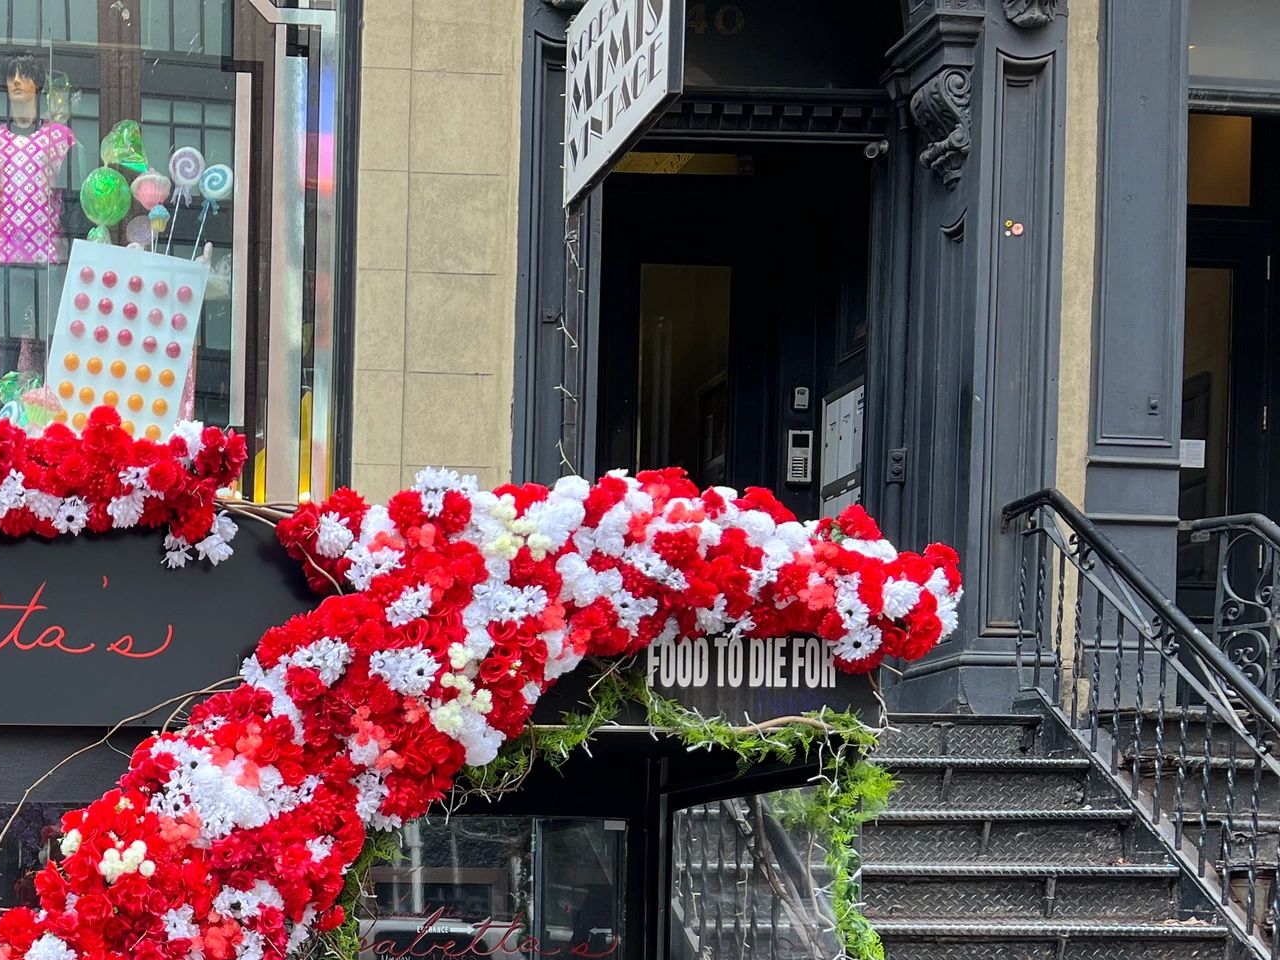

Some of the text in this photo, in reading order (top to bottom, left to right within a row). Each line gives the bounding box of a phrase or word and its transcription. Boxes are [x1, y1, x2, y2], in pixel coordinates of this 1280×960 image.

[570, 32, 663, 172] VINTAGE
[647, 636, 836, 688] FOOD TO DIE FOR
[416, 926, 450, 934] ERANCE
